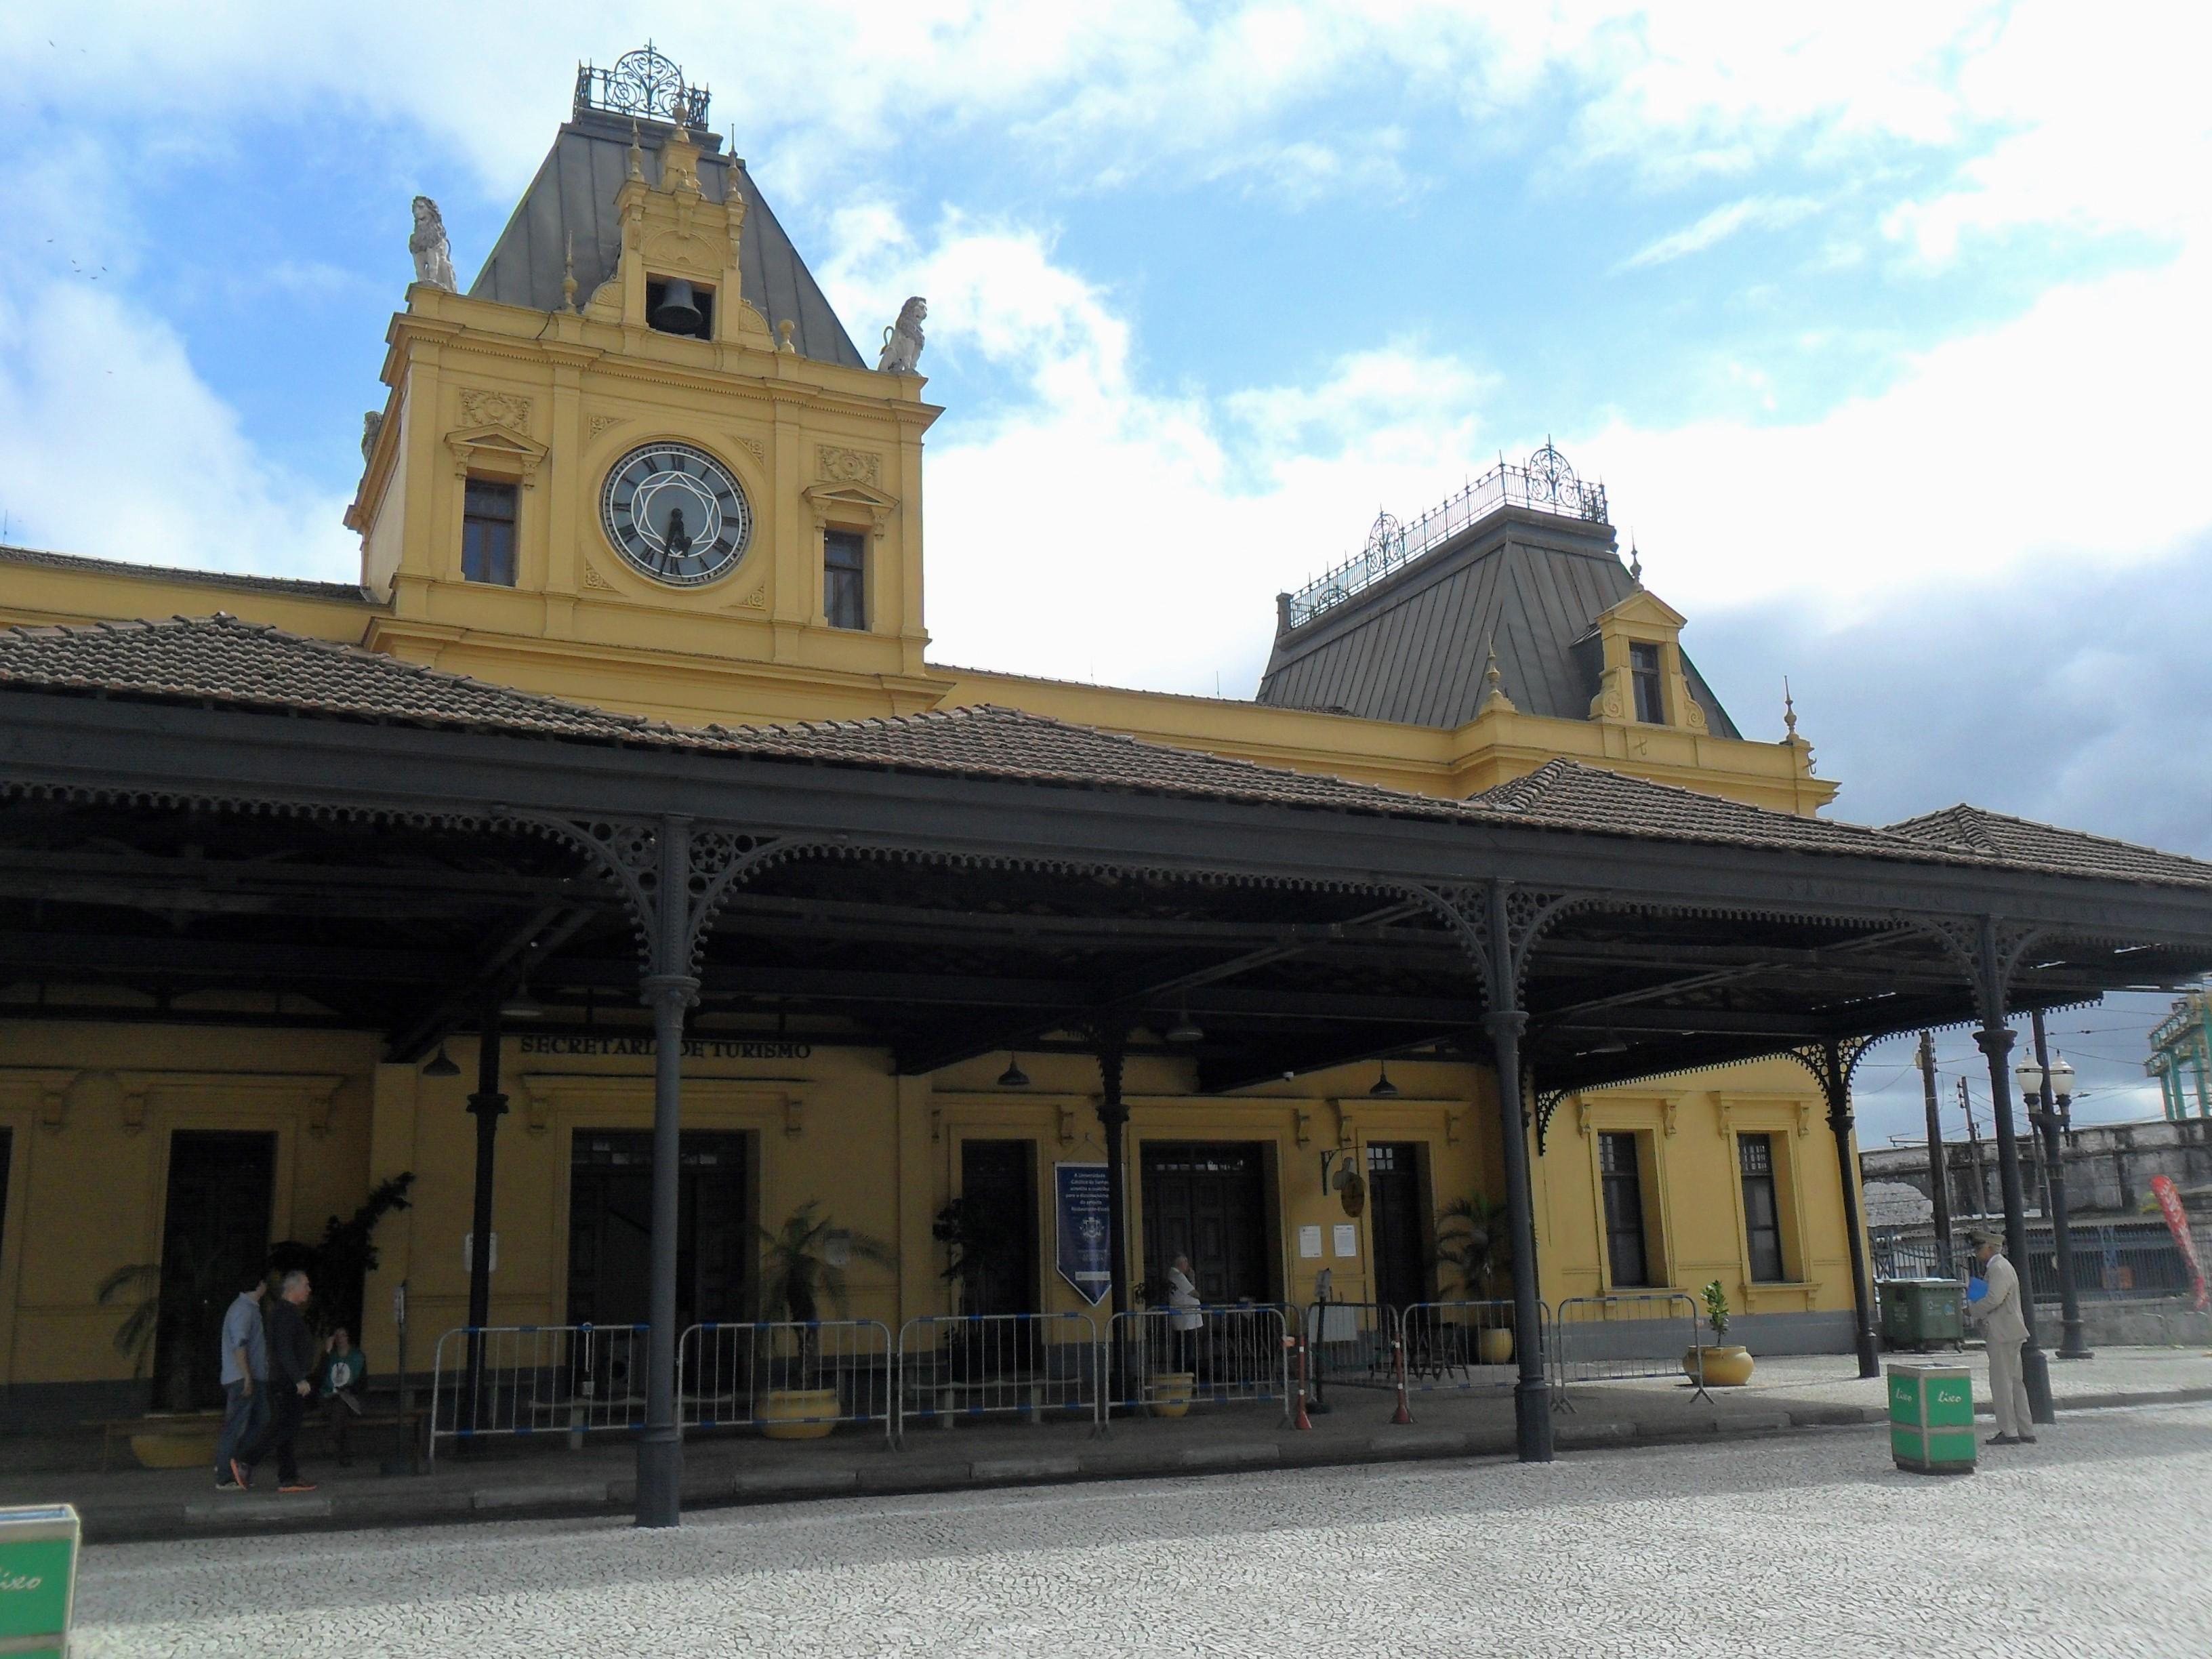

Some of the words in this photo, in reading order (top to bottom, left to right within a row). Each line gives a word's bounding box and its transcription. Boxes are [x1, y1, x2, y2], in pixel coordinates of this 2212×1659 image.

[520, 1036, 656, 1055] SECRETARI
[712, 1041, 812, 1059] TURISMO
[0, 1568, 42, 1591] ixo
